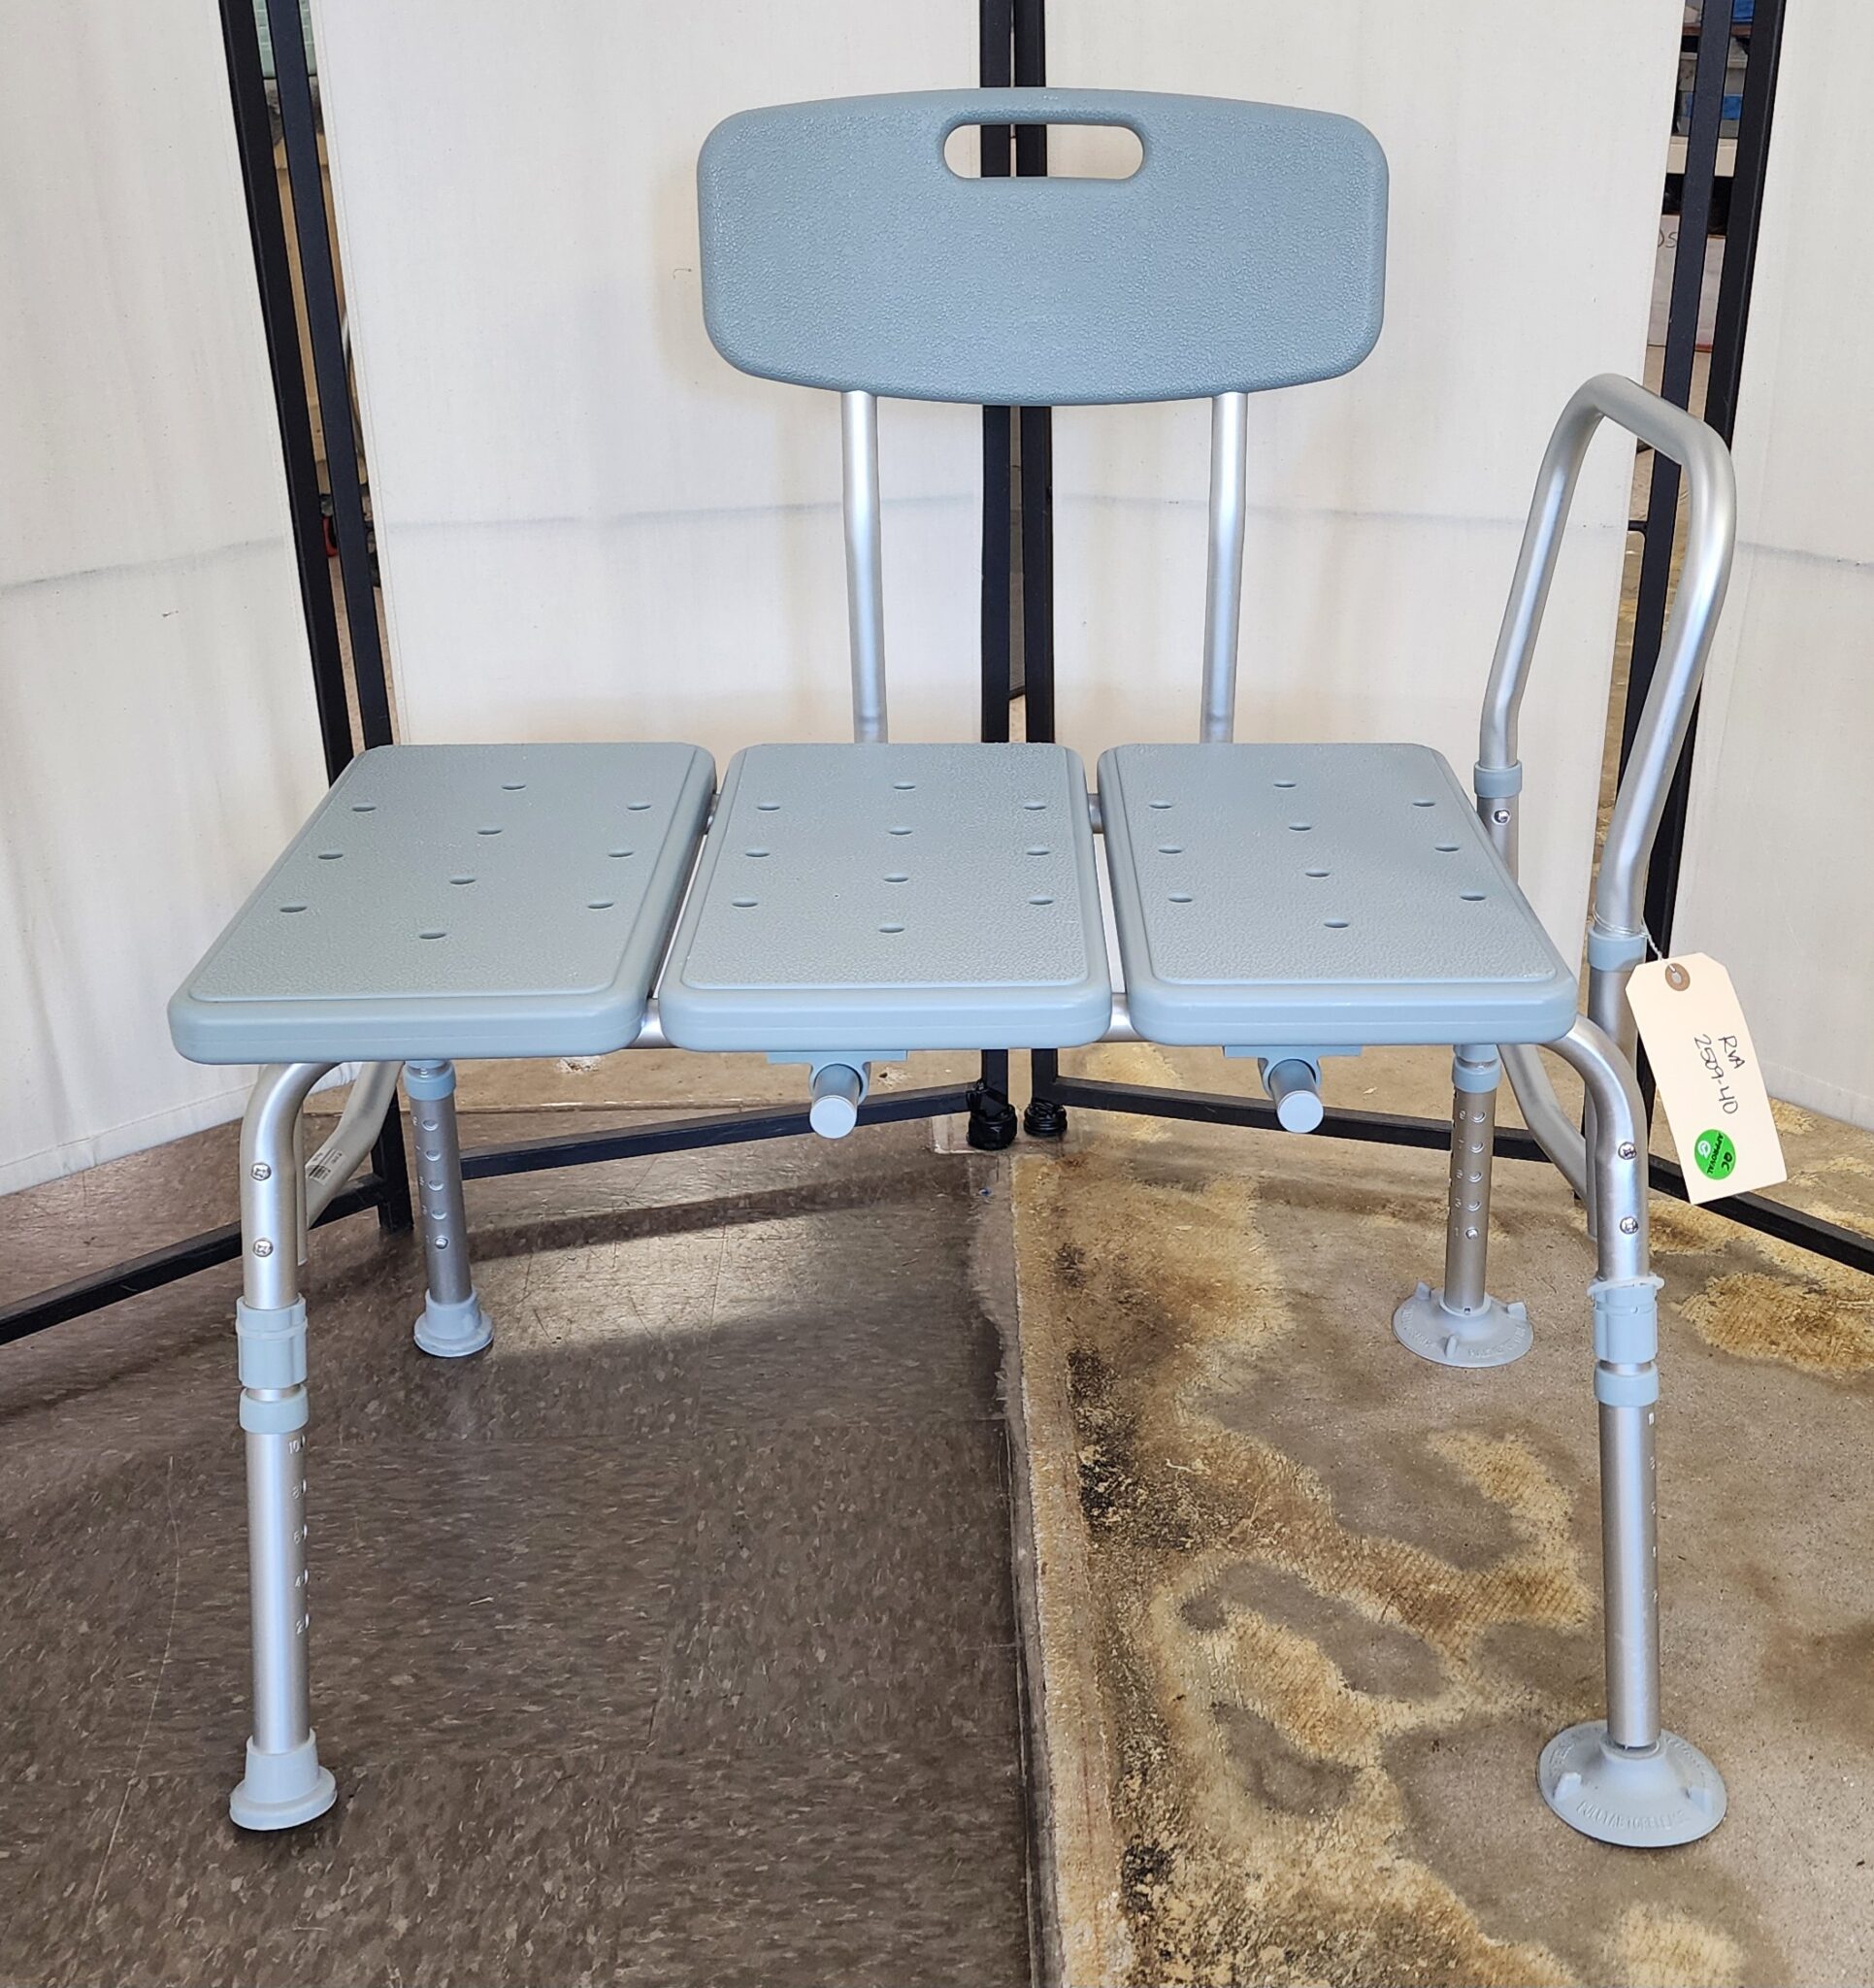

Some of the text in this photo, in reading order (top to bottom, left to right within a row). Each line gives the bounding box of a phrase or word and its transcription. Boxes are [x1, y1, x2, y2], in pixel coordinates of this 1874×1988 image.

[1718, 1035, 1746, 1069] RVA
[1706, 1132, 1724, 1175] APPROVAL
[1722, 1151, 1733, 1172] QC
[288, 1440, 301, 1455] 10
[295, 1619, 303, 1635] 2
